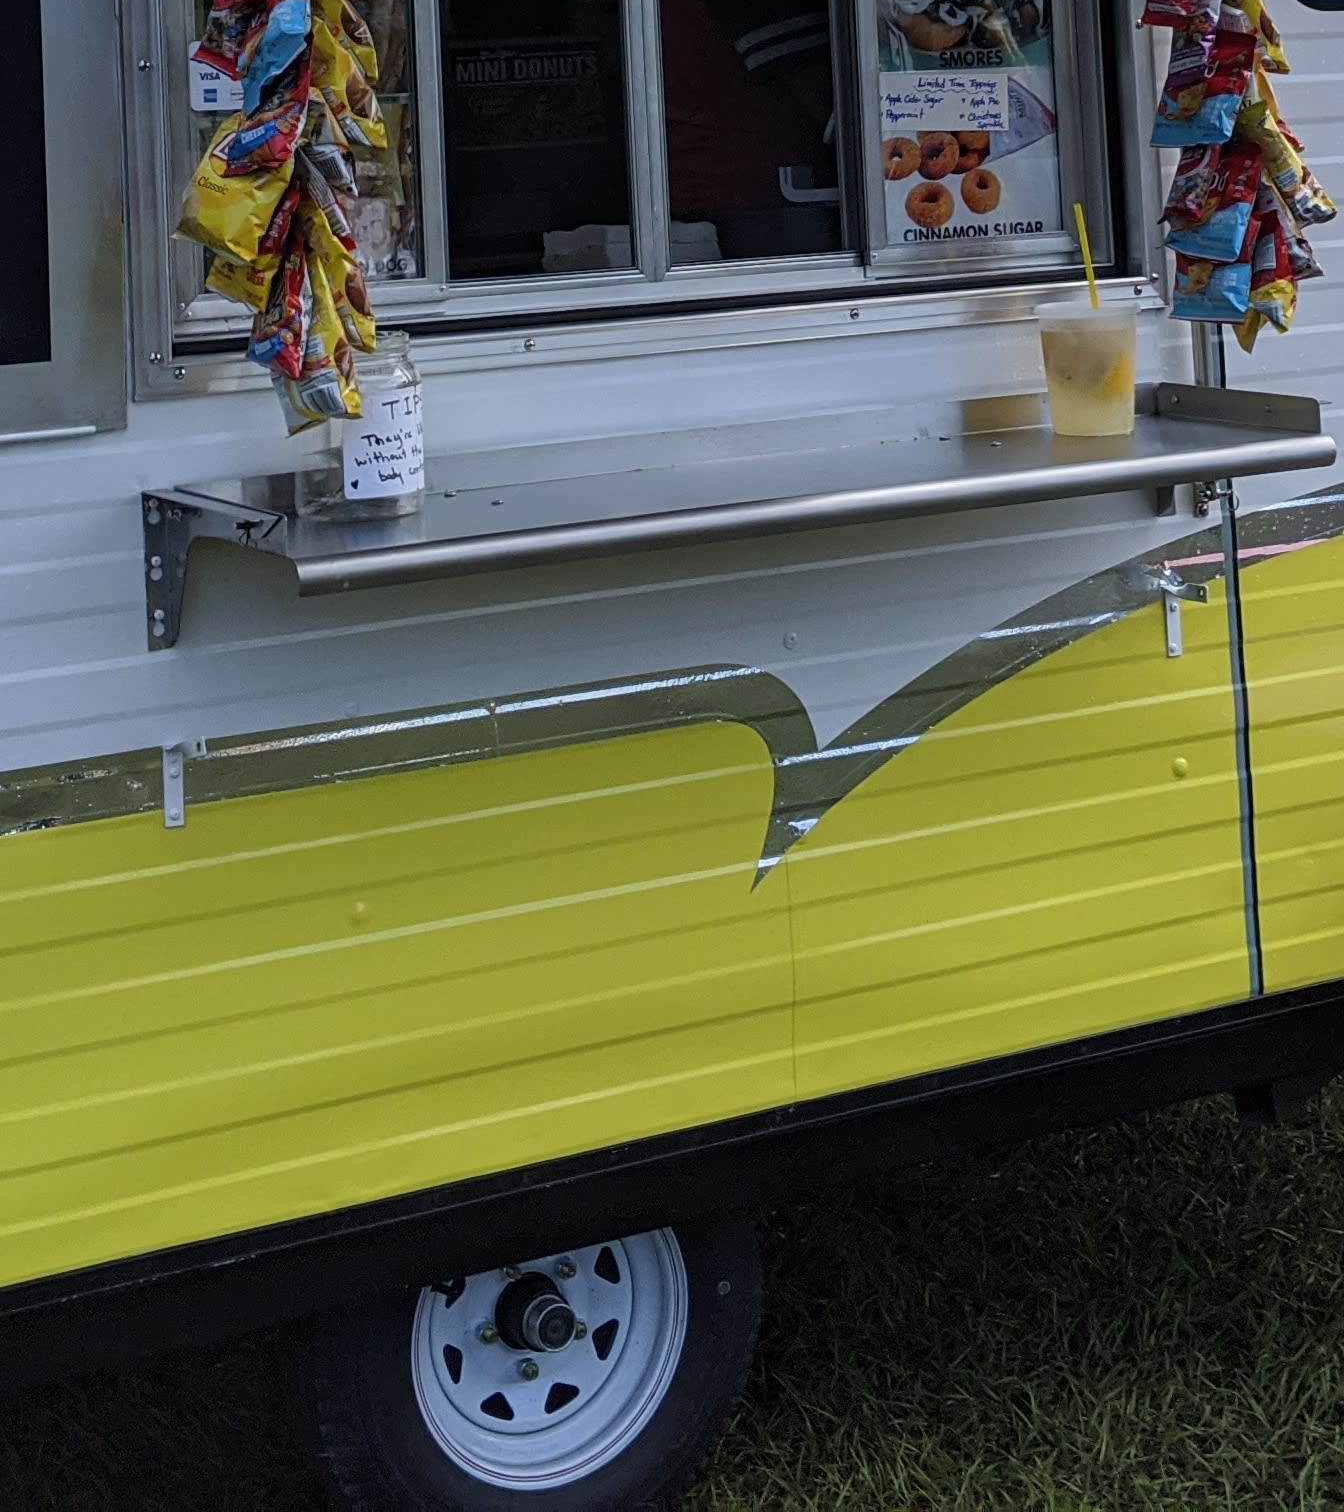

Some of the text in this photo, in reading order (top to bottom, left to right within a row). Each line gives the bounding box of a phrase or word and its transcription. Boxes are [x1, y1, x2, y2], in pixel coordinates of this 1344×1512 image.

[456, 54, 598, 82] MINI DONUTS
[939, 50, 1003, 67] SMORES
[199, 72, 221, 81] VISA
[197, 175, 230, 196] Classic
[903, 220, 1044, 242] CINNAMON SUGAR
[354, 448, 408, 467] without
[377, 467, 405, 485] body
